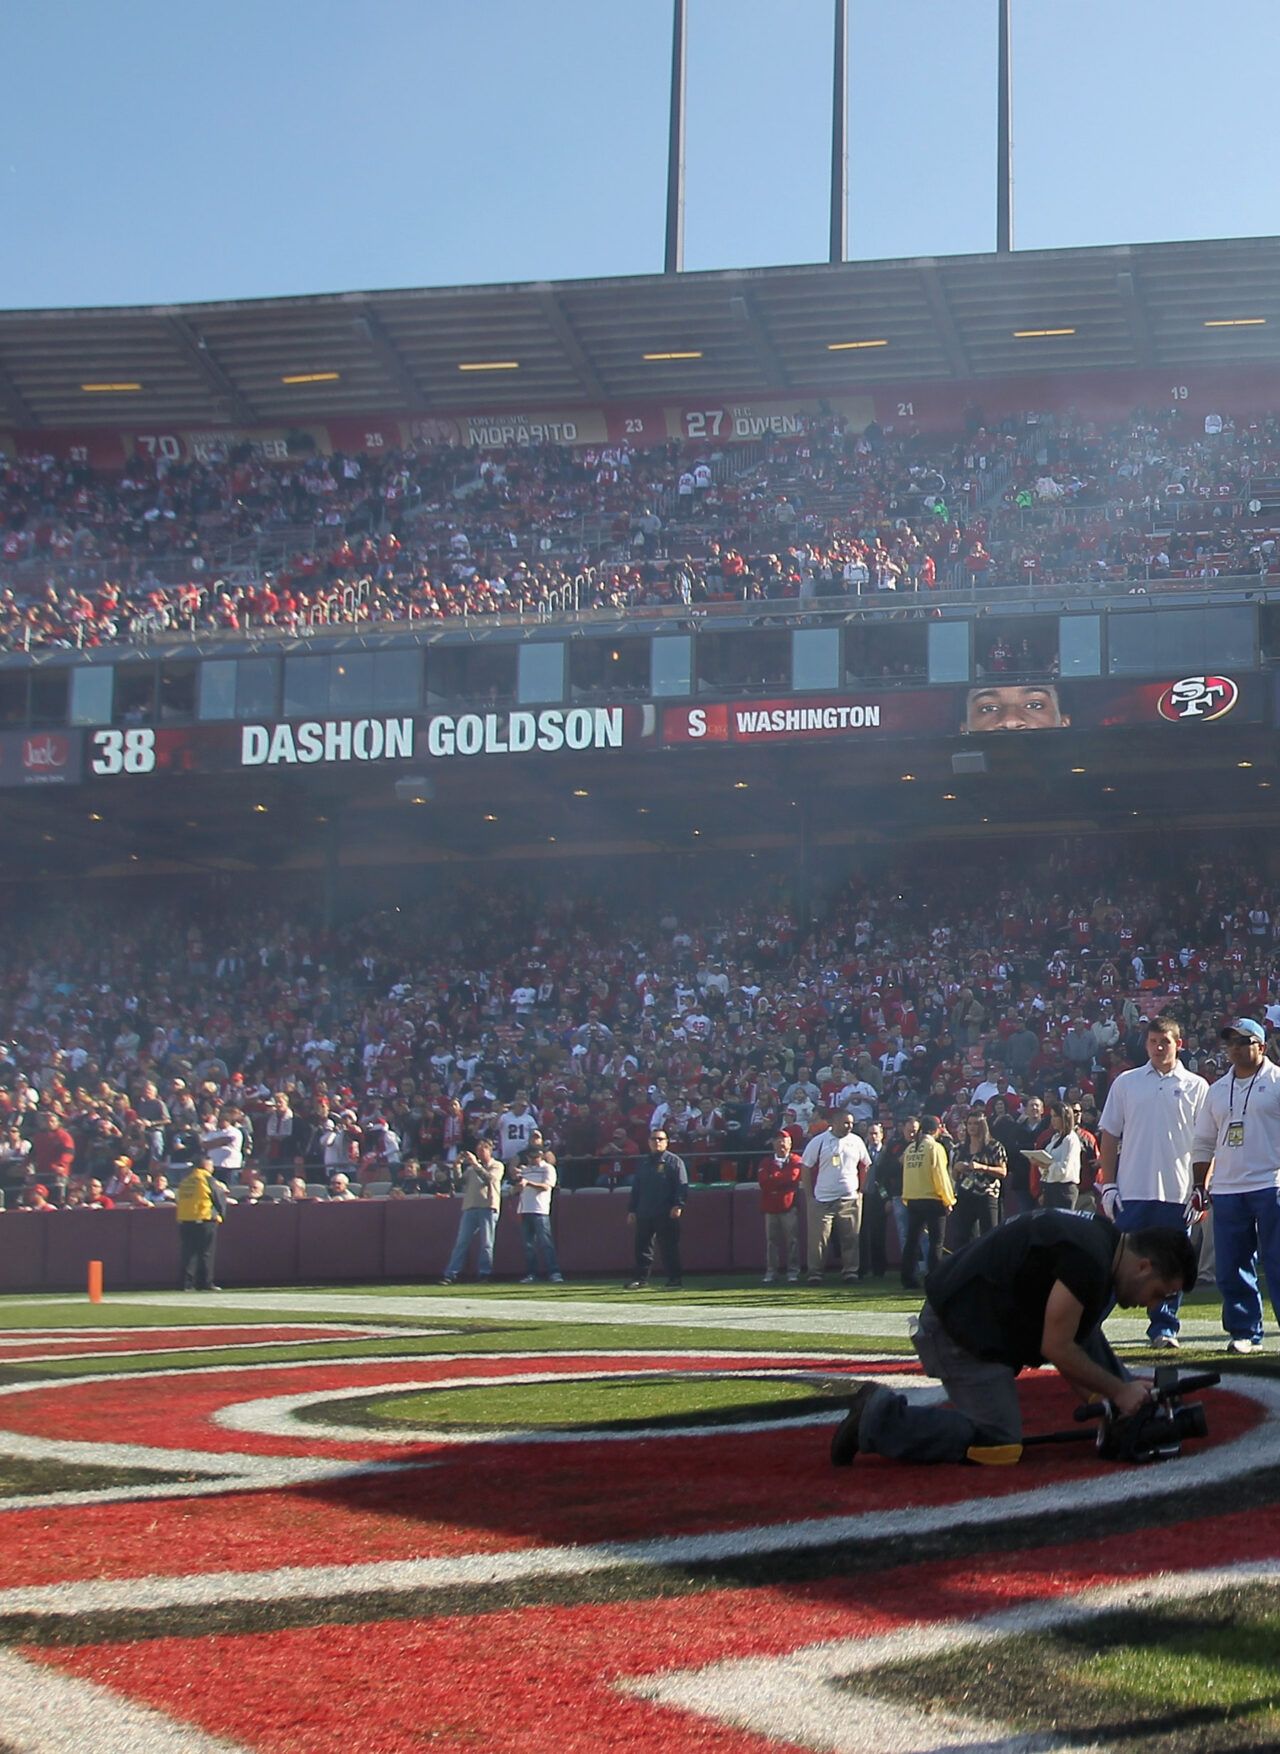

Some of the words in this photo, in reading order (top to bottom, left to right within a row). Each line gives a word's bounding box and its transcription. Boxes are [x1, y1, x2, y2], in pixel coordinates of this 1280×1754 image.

[1171, 386, 1188, 400] 19
[897, 402, 914, 416] 21
[625, 419, 643, 433] 23
[686, 410, 724, 437] 27
[736, 415, 803, 436] OWEN
[365, 433, 384, 447] 25
[687, 709, 708, 737] S
[736, 705, 880, 733] WASHINGTON
[241, 717, 413, 765] DASHON
[428, 707, 623, 756] GOLDSON
[92, 728, 156, 775] 38
[1101, 974, 1114, 985] 21
[508, 1124, 525, 1140] 21
